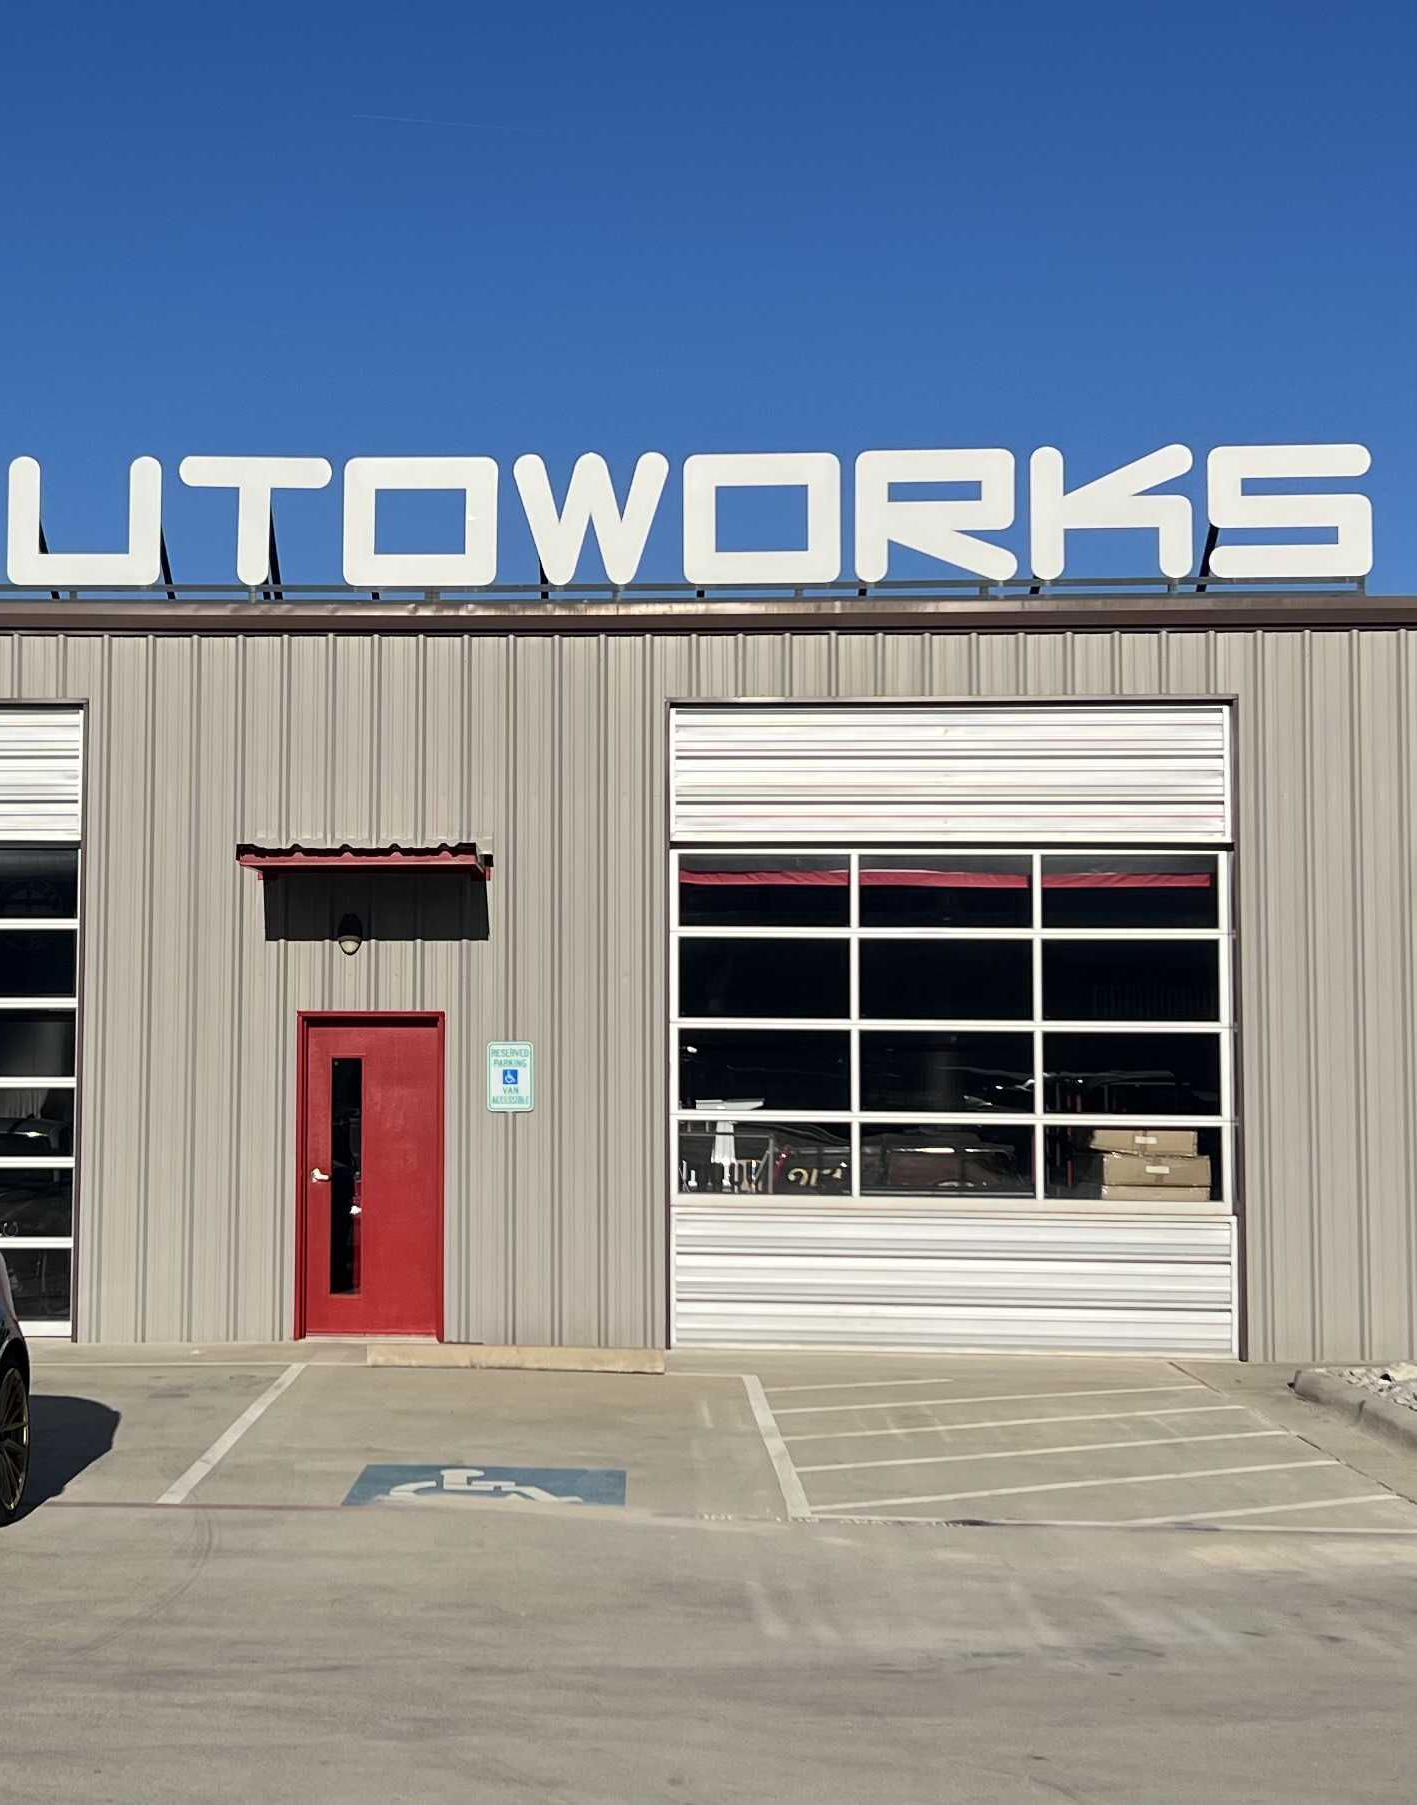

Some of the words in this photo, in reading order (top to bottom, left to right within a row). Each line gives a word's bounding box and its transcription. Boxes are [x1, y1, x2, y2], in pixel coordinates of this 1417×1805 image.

[491, 1048, 530, 1058] RESERVED
[493, 1059, 528, 1068] PARKING
[502, 1086, 519, 1095] VAN
[491, 1095, 530, 1105] ACCESSIBLE
